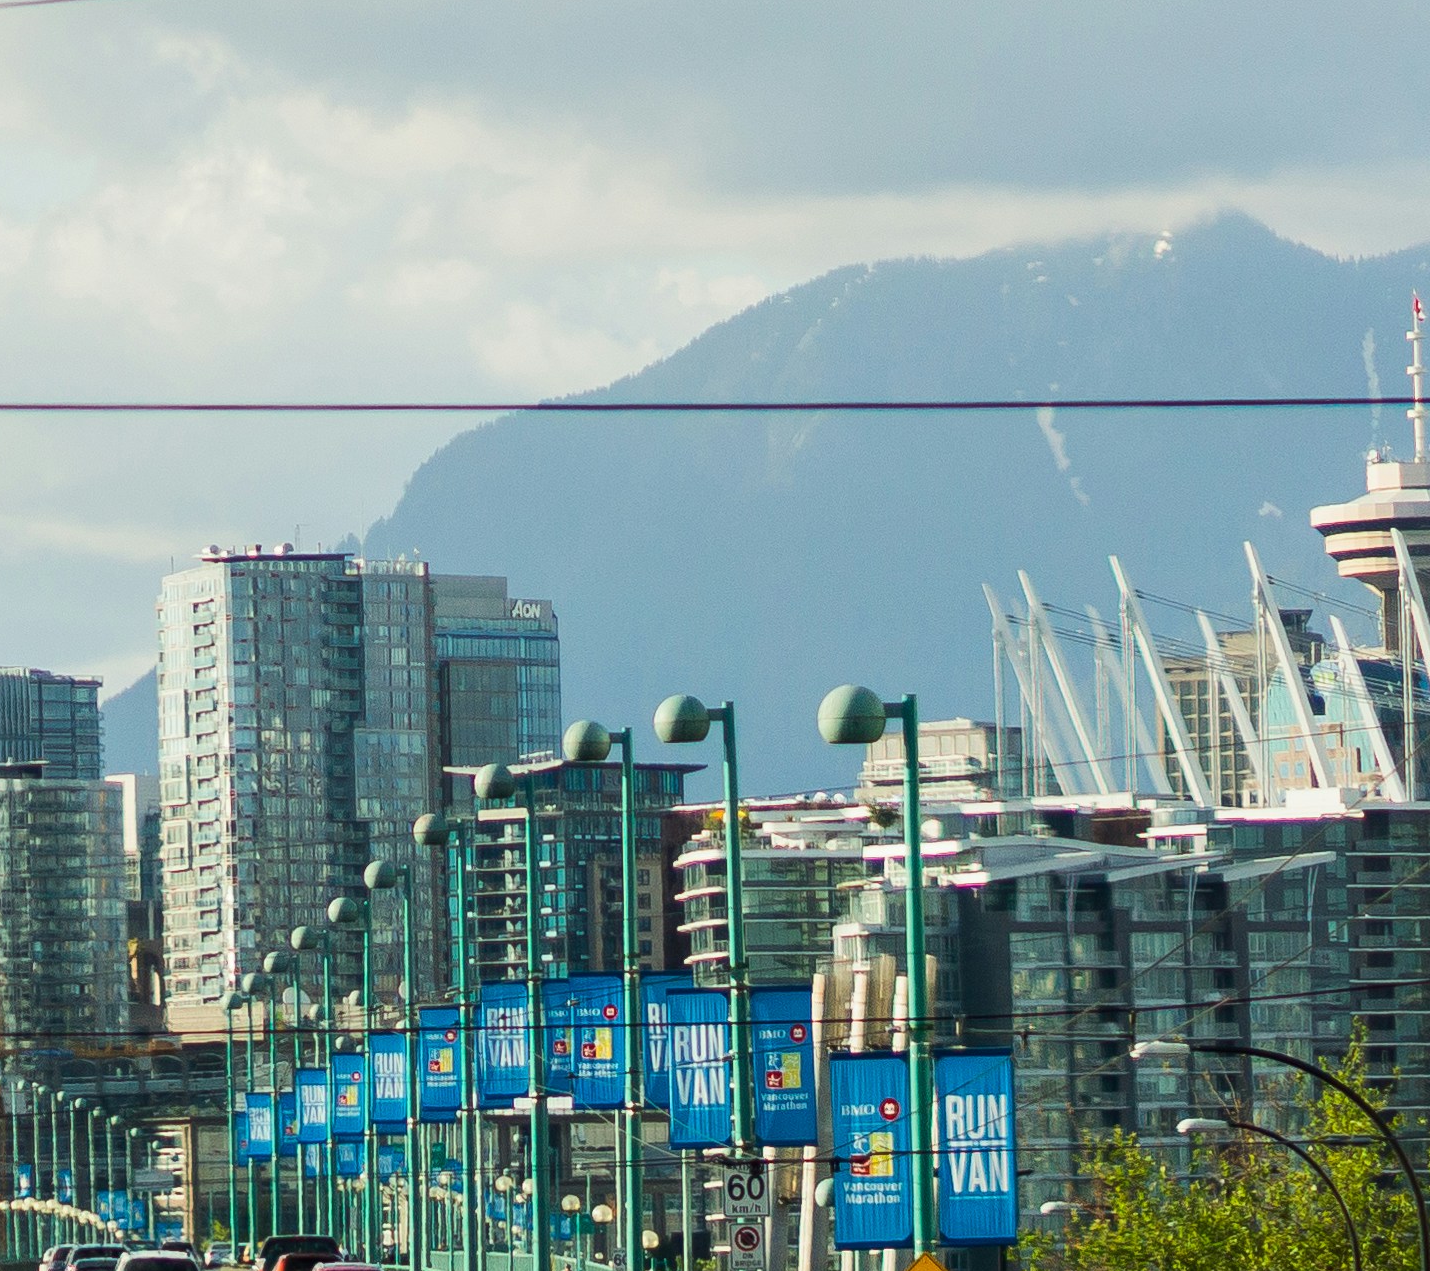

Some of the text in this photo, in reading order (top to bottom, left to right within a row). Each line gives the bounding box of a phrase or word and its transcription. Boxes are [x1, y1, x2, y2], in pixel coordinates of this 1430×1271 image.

[512, 600, 541, 618] AON
[486, 1007, 525, 1034] RUN
[576, 1008, 601, 1017] BMO
[674, 1024, 724, 1063] RUN
[759, 1030, 786, 1040] BMO
[488, 1038, 525, 1067] VAN
[374, 1052, 404, 1073] RUN
[301, 1085, 325, 1103] RUN
[375, 1077, 404, 1099] VAN
[676, 1067, 725, 1106] VAN
[761, 1092, 809, 1102] Vancouver
[302, 1105, 326, 1125] VAN
[763, 1102, 808, 1111] Marathon
[841, 1105, 875, 1116] BMO
[945, 1094, 1007, 1140] RUN
[250, 1124, 271, 1141] VAN
[948, 1147, 1009, 1193] VAN
[727, 1174, 765, 1201] 60
[843, 1181, 903, 1192] Vancouver
[846, 1193, 901, 1204] Marathon
[732, 1203, 762, 1214] km/h
